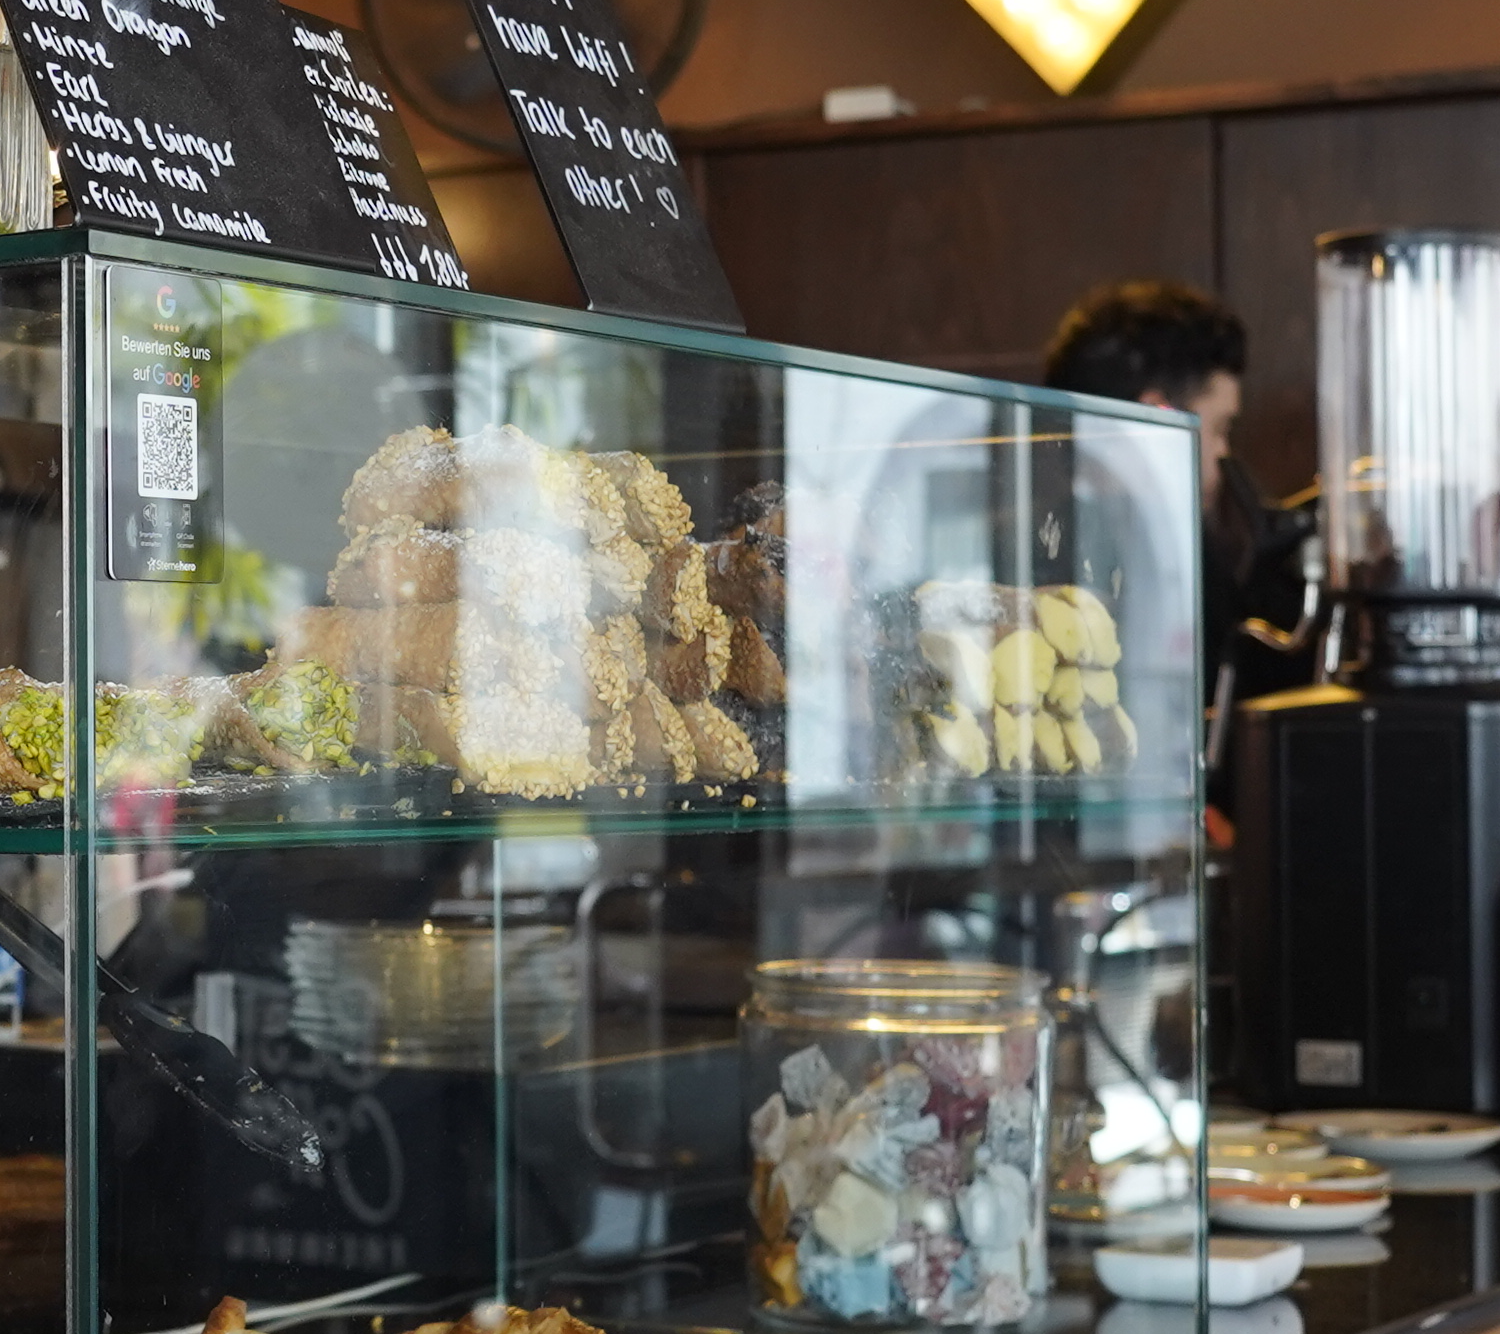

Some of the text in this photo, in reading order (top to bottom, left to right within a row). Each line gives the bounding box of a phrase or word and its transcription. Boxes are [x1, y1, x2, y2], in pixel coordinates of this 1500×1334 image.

[31, 21, 115, 69] Minze
[487, 3, 559, 61] have
[46, 61, 109, 108] Earl
[57, 99, 236, 178] Herbs & Ginger
[323, 120, 380, 161] Schoko
[509, 88, 678, 168] Talk to each
[72, 141, 209, 194] Lemon Fresh
[337, 156, 391, 193] Zitrone
[87, 180, 272, 245] Fruity Camomile
[348, 186, 428, 228] Haselnuss
[121, 335, 211, 361] Bewerten Sie uns
[133, 363, 201, 394] auf Google
